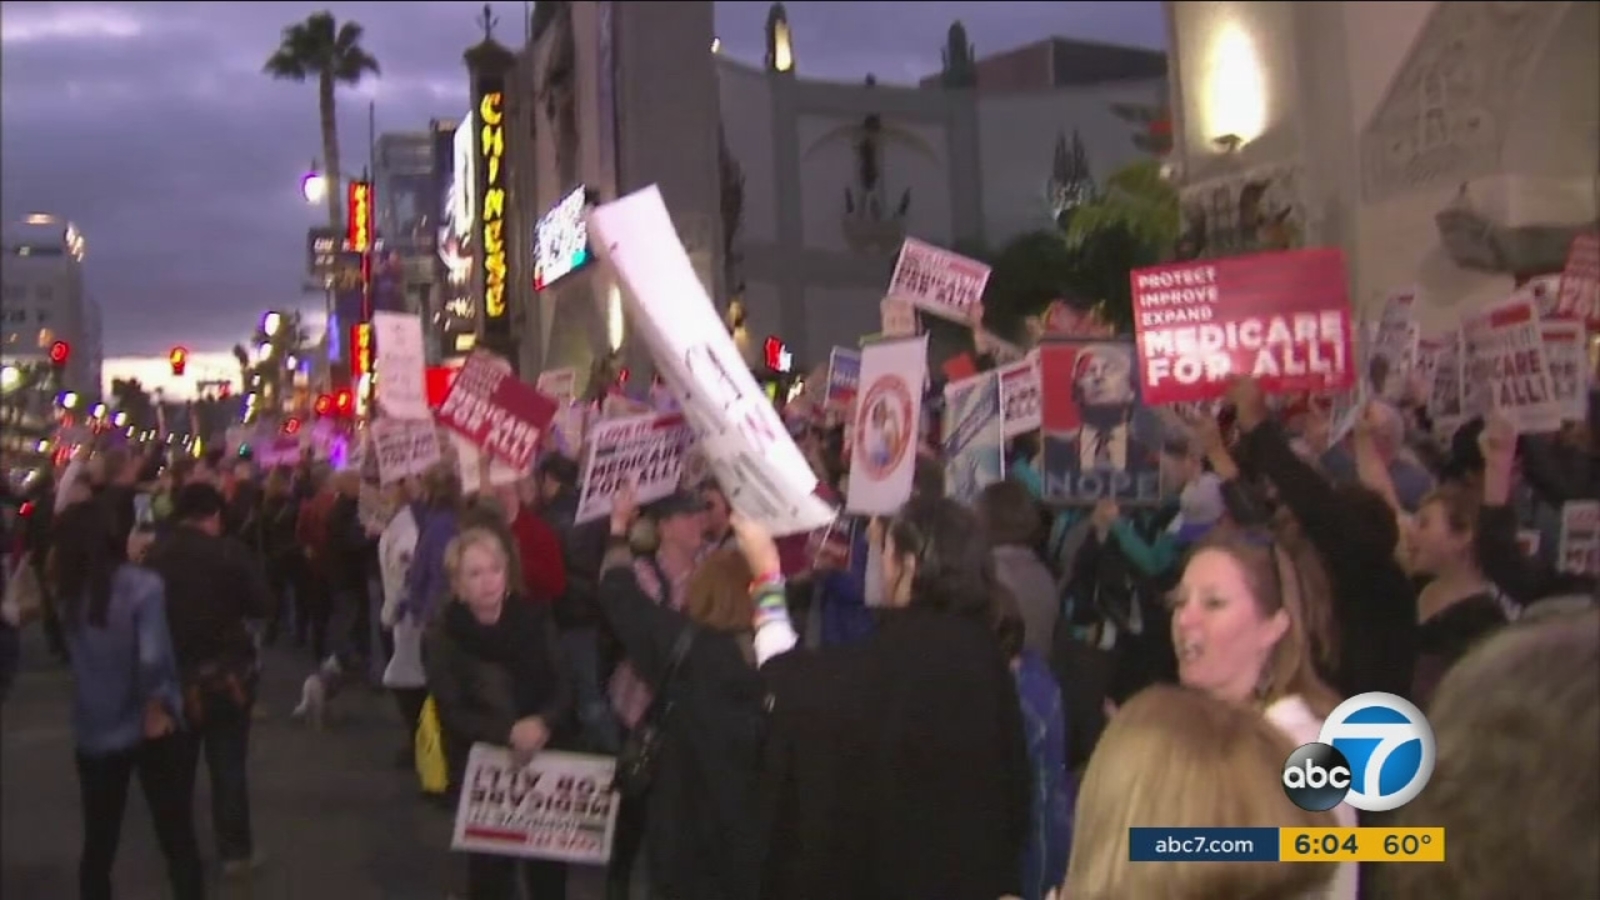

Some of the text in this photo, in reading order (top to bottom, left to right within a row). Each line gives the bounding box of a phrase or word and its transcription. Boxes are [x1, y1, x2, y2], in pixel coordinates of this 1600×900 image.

[480, 92, 505, 318] CHINESE
[1137, 266, 1217, 289] PROTECT
[1139, 285, 1218, 308] IMPROVE
[1142, 307, 1213, 327] EXPAND
[1144, 310, 1343, 358] MEDICARE
[1147, 338, 1346, 387] FOR ALL!
[588, 444, 684, 481] MEDICARE
[1048, 470, 1159, 498] NOPE
